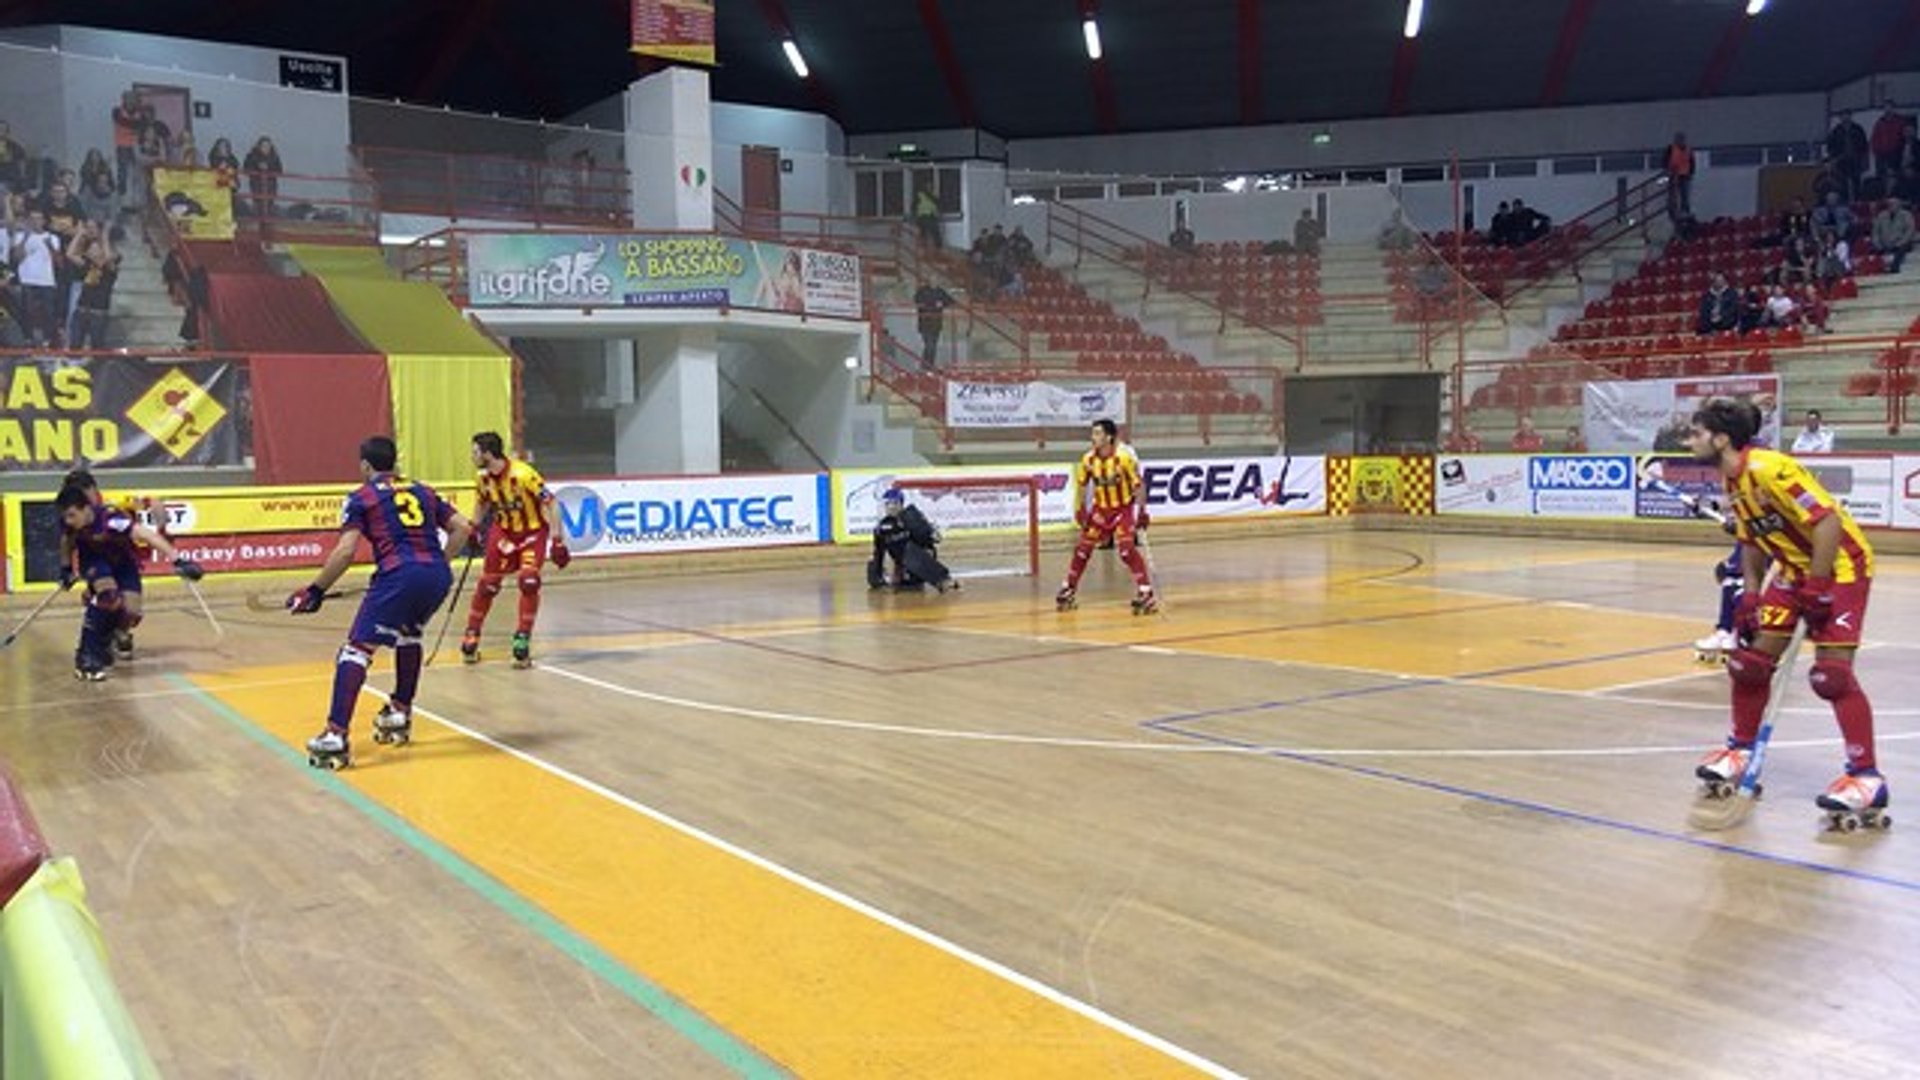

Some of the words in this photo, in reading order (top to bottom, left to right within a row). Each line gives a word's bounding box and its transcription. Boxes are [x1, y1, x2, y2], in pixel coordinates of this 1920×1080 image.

[618, 241, 641, 257] LO
[645, 236, 727, 256] SHOPPING
[624, 257, 642, 278] A
[647, 254, 744, 278] BASSANO
[393, 491, 424, 527] 3
[558, 495, 794, 539] MEDIATEC
[163, 546, 236, 564] ockey
[240, 543, 323, 559] Bassano
